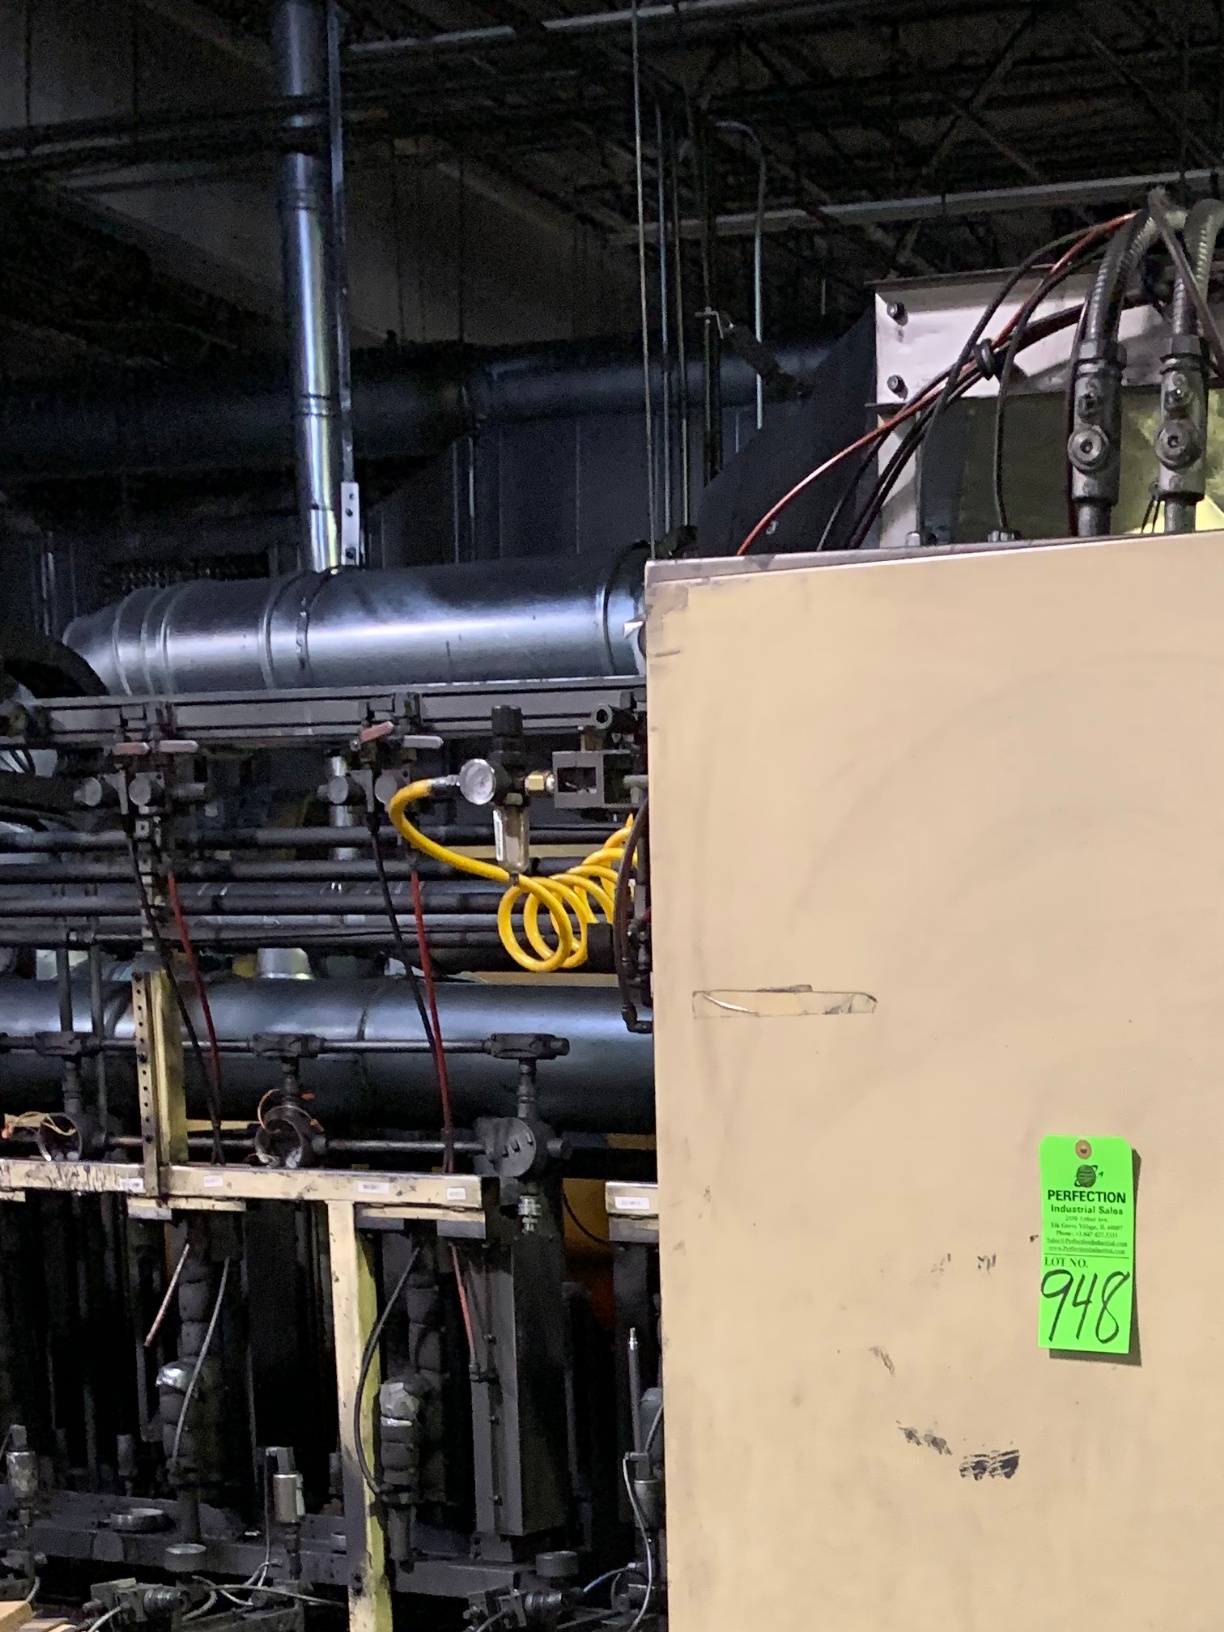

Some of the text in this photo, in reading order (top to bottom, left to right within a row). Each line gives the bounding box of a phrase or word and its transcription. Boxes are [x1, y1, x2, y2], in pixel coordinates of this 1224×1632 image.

[1047, 1189, 1126, 1204] PERFECTION
[1050, 1204, 1123, 1215] Industrial Sales
[1044, 1256, 1089, 1268] LOT NO.
[1041, 1269, 1130, 1344] 948
